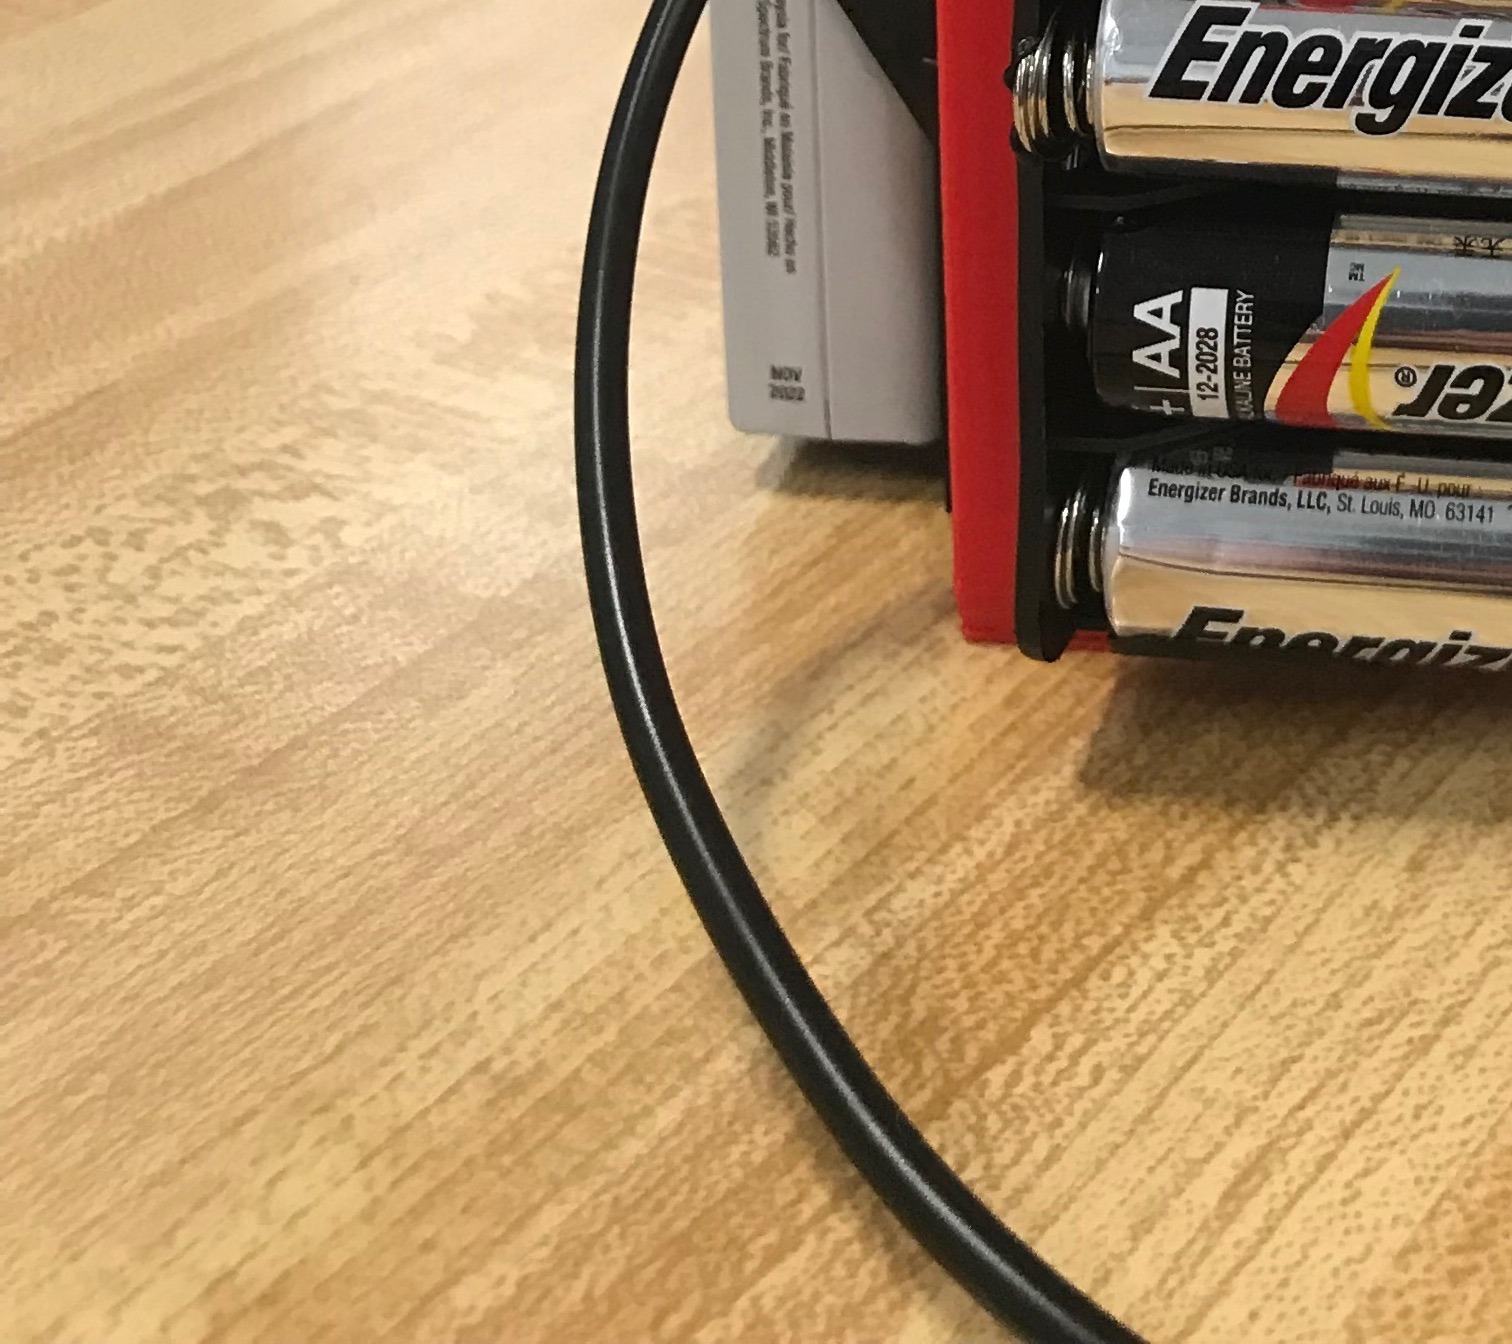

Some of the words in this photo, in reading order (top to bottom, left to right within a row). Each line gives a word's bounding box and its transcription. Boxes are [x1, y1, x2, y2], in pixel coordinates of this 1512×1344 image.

[1131, 288, 1184, 380] AA
[1194, 326, 1220, 401] 12-2028
[1232, 288, 1255, 368] BATTERY
[1147, 477, 1226, 503] Energizer
[1229, 483, 1292, 511] Brands,
[1296, 489, 1331, 515] LLC,
[1361, 495, 1404, 520] Louis,
[1445, 501, 1494, 524] 63141
